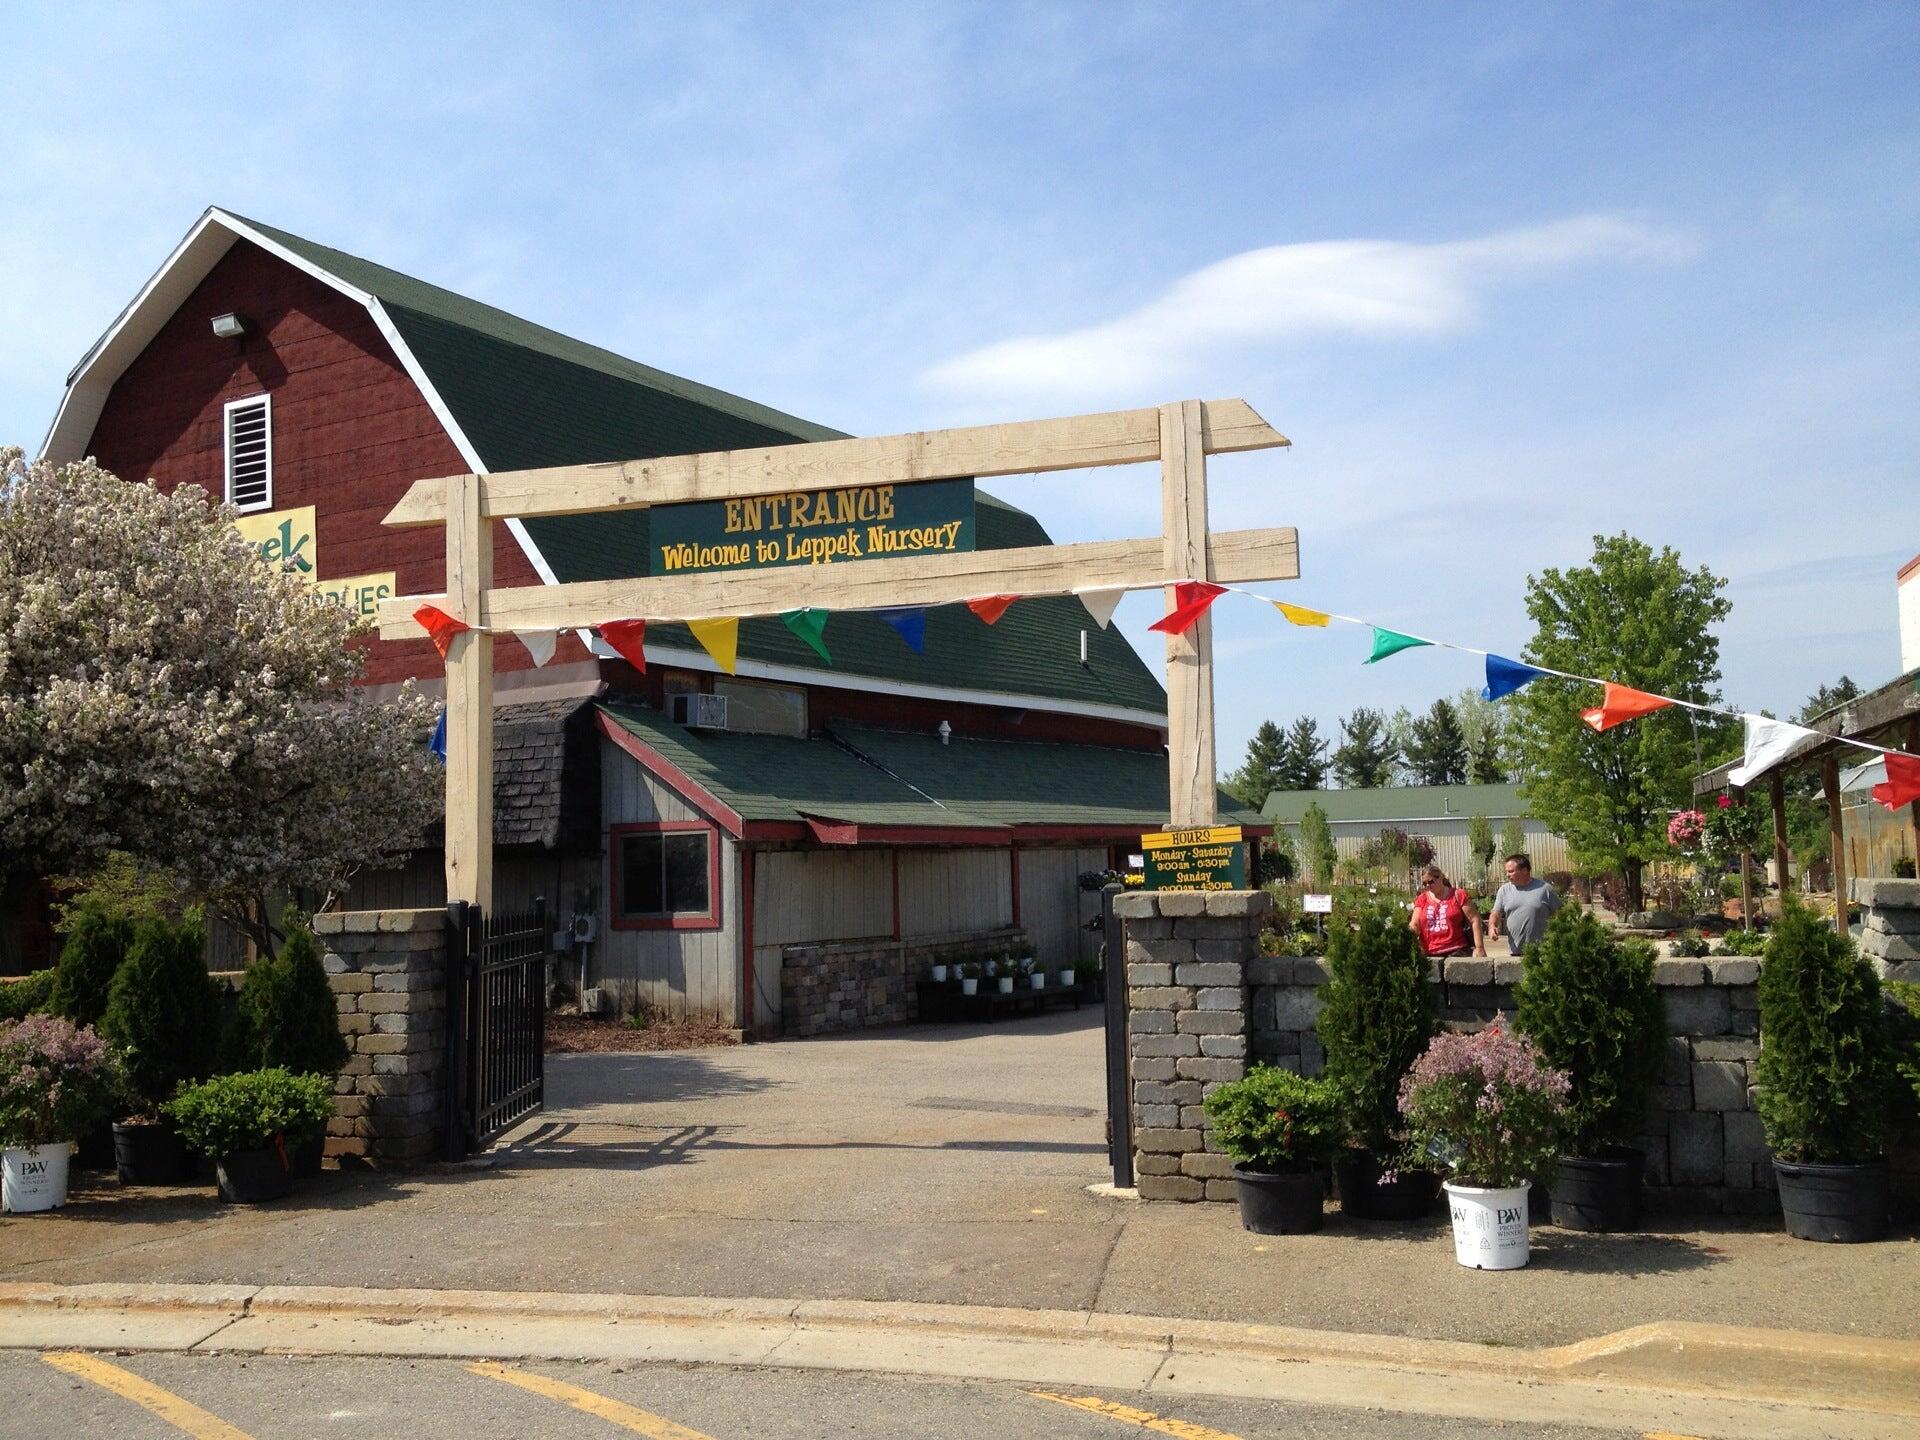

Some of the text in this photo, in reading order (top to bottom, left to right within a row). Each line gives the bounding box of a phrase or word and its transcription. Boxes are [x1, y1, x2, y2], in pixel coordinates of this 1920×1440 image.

[724, 484, 895, 533] ENTRANCE
[661, 520, 962, 570] Welcome to Leppek Nursery
[1172, 830, 1211, 845] HOURS
[1151, 850, 1187, 862] Monday
[1192, 846, 1234, 859] Saturday
[1176, 871, 1212, 883] Sunday
